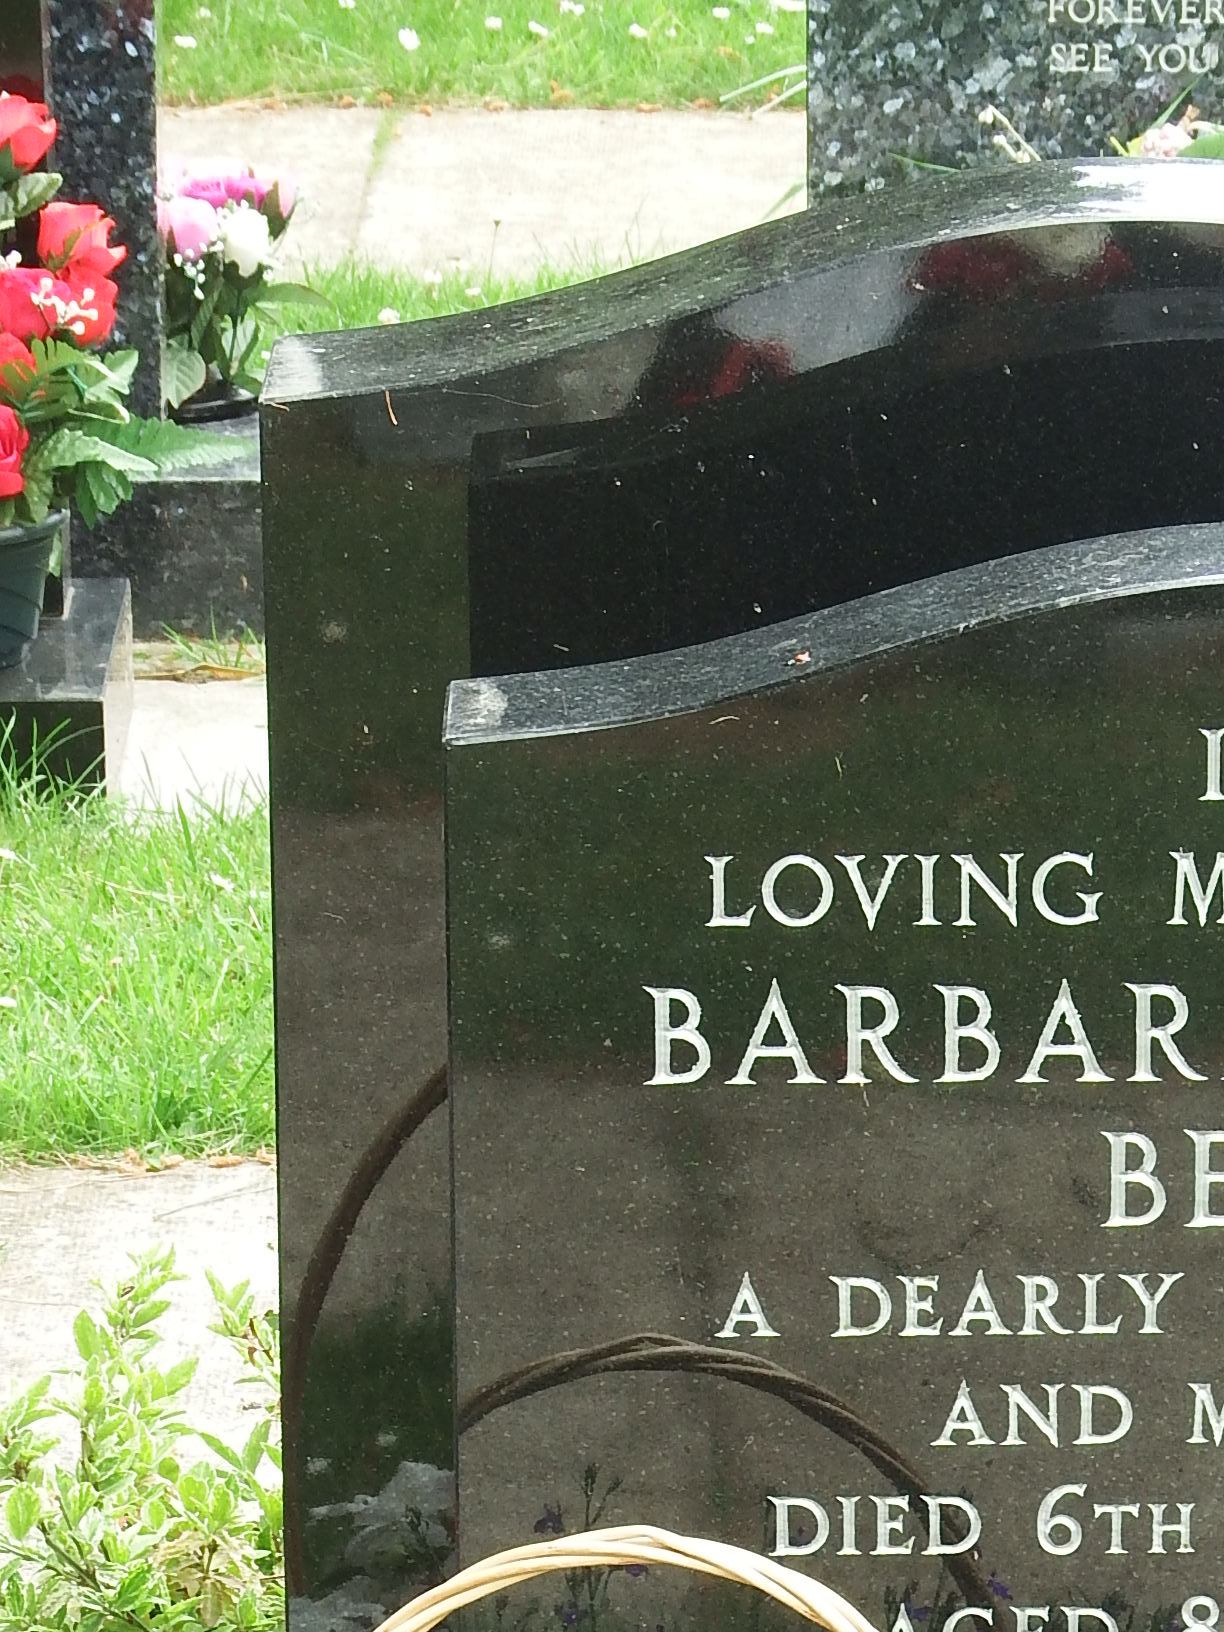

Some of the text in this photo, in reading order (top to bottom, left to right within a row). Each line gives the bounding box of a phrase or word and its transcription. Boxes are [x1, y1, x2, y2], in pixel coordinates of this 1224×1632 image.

[1049, 43, 1113, 72] SEE
[1135, 43, 1218, 73] YOU
[703, 851, 1104, 931] LOVING
[713, 1271, 782, 1339] A
[828, 1268, 1185, 1338] DEARLY
[929, 1379, 1134, 1449] AND
[766, 1494, 982, 1557] DIED
[1036, 1482, 1196, 1556] 6TH
